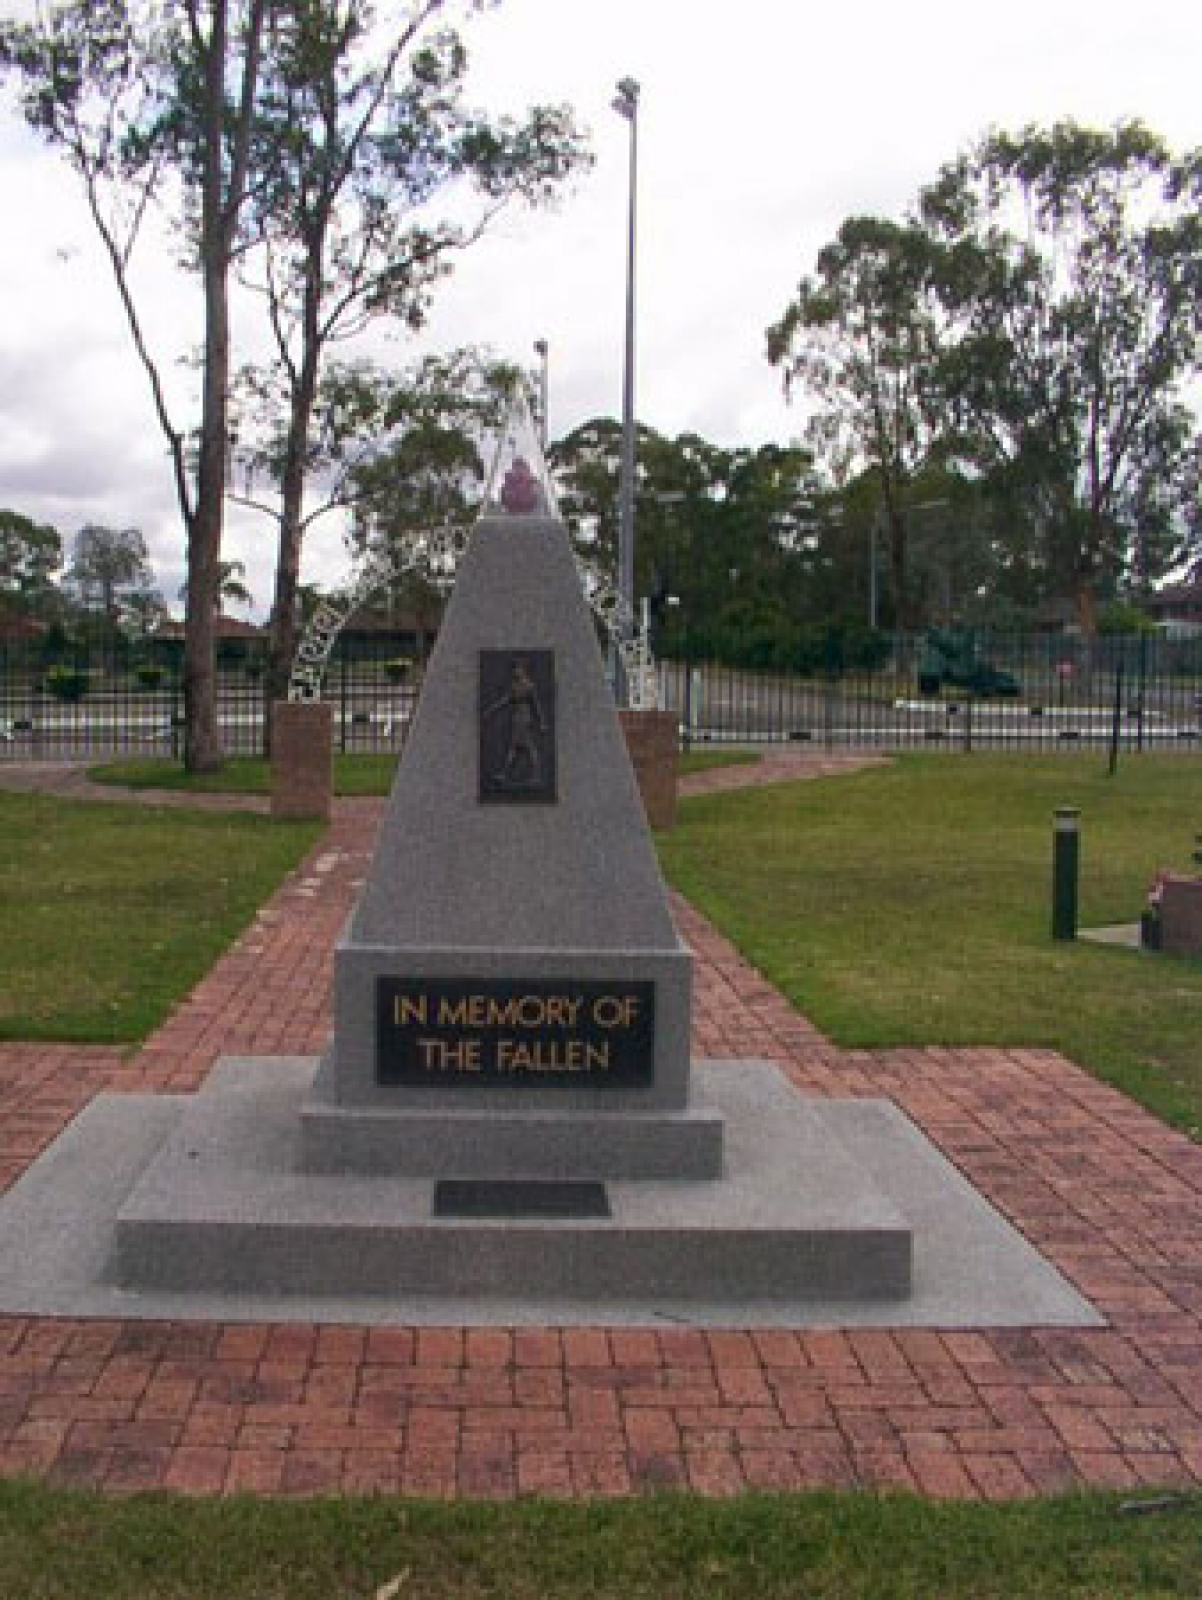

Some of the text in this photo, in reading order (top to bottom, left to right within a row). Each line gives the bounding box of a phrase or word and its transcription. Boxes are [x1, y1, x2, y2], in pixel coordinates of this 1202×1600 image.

[393, 995, 638, 1027] IN MEMORY OF
[418, 1038, 609, 1071] THE FALLEN
